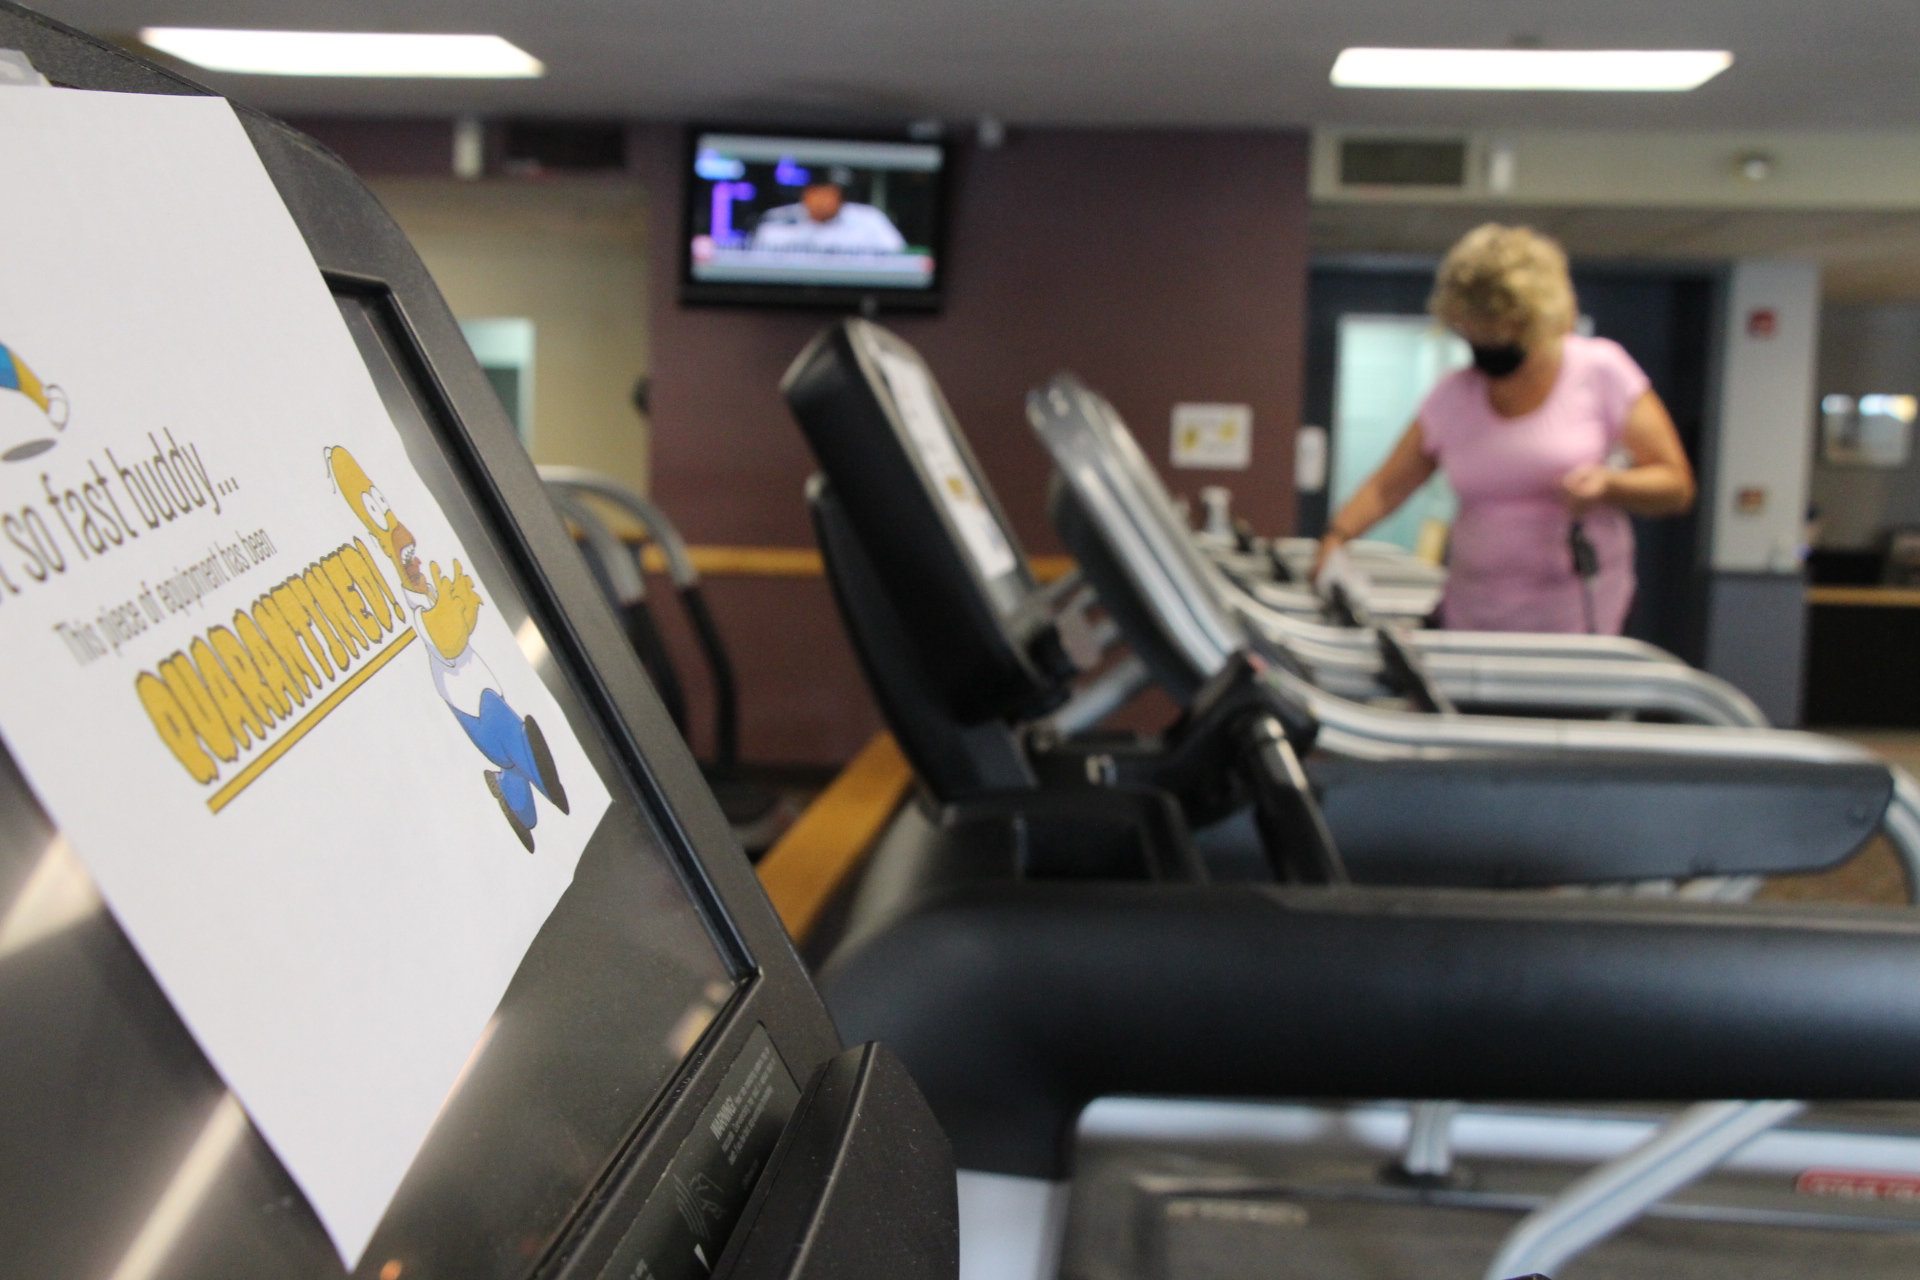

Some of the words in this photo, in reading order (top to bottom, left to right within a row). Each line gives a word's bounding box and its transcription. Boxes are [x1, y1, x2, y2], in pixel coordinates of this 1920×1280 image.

[2, 505, 66, 583] so
[40, 459, 139, 561] fast
[105, 427, 239, 529] buddy...
[53, 620, 108, 667] This
[97, 602, 148, 657] piece
[138, 580, 165, 624] of
[156, 547, 230, 617] equipment
[214, 541, 251, 577] has
[235, 528, 277, 565] been
[135, 535, 406, 786] QUARANTINED!
